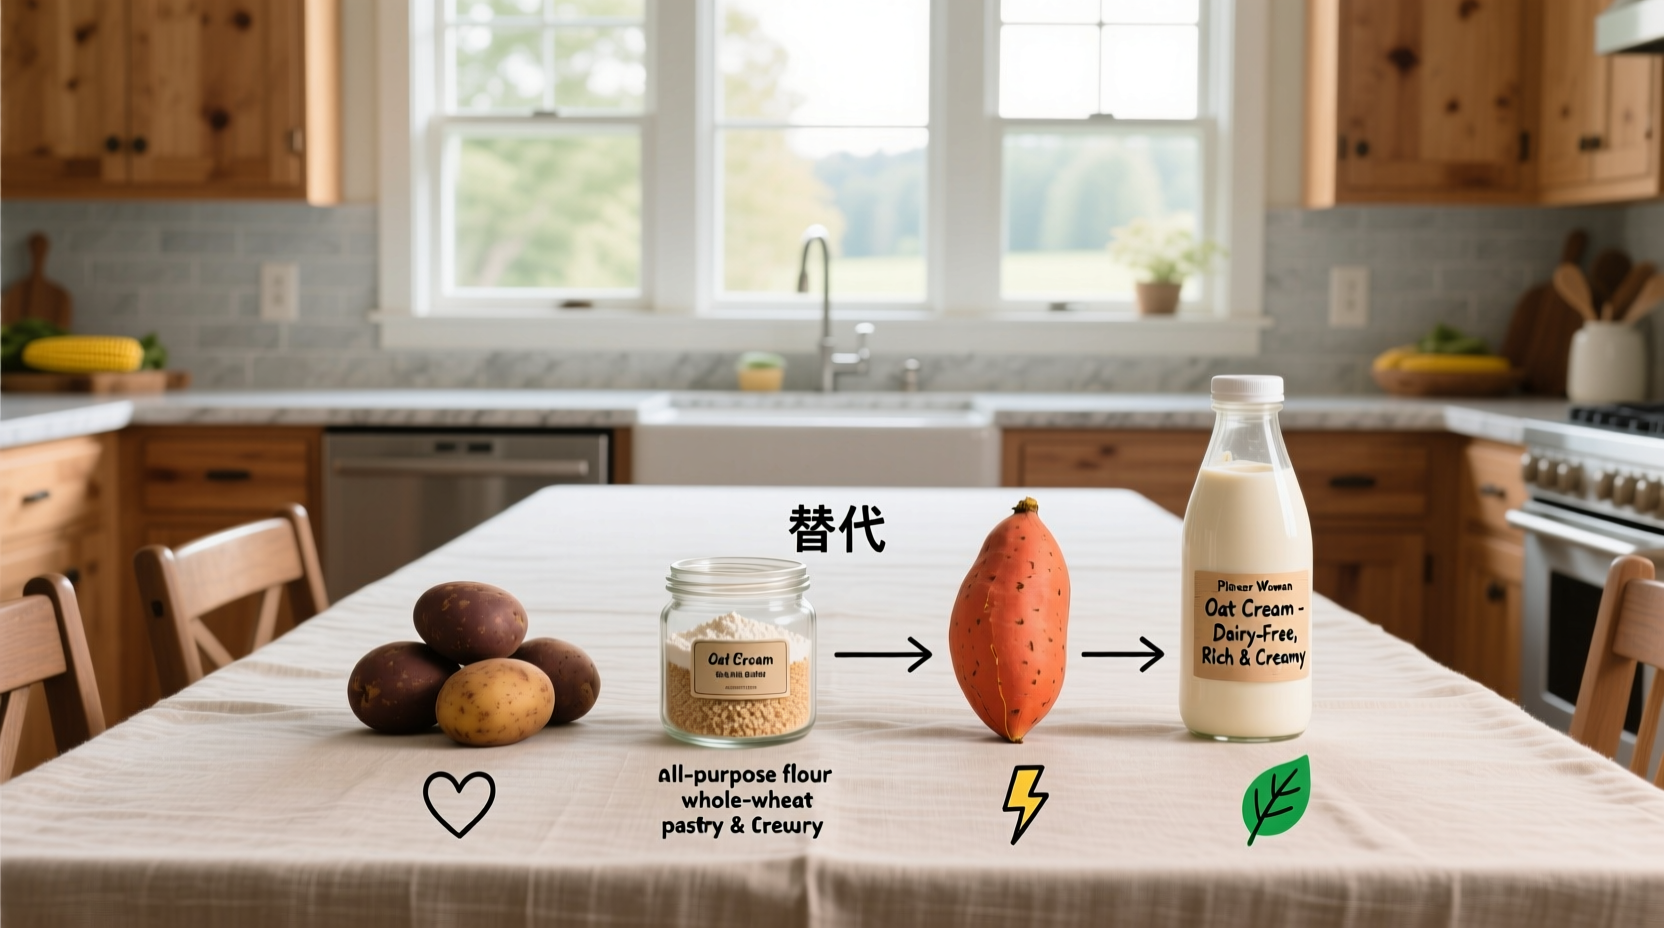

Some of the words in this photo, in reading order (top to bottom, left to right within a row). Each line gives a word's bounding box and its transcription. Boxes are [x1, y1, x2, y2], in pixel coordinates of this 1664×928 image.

[1205, 597, 1237, 617] Oat
[1241, 598, 1294, 618] Cream
[1212, 622, 1298, 648] Dairy-Free,
[1202, 646, 1234, 666] Rich
[1239, 648, 1251, 666] &
[1255, 648, 1306, 670] Creamy
